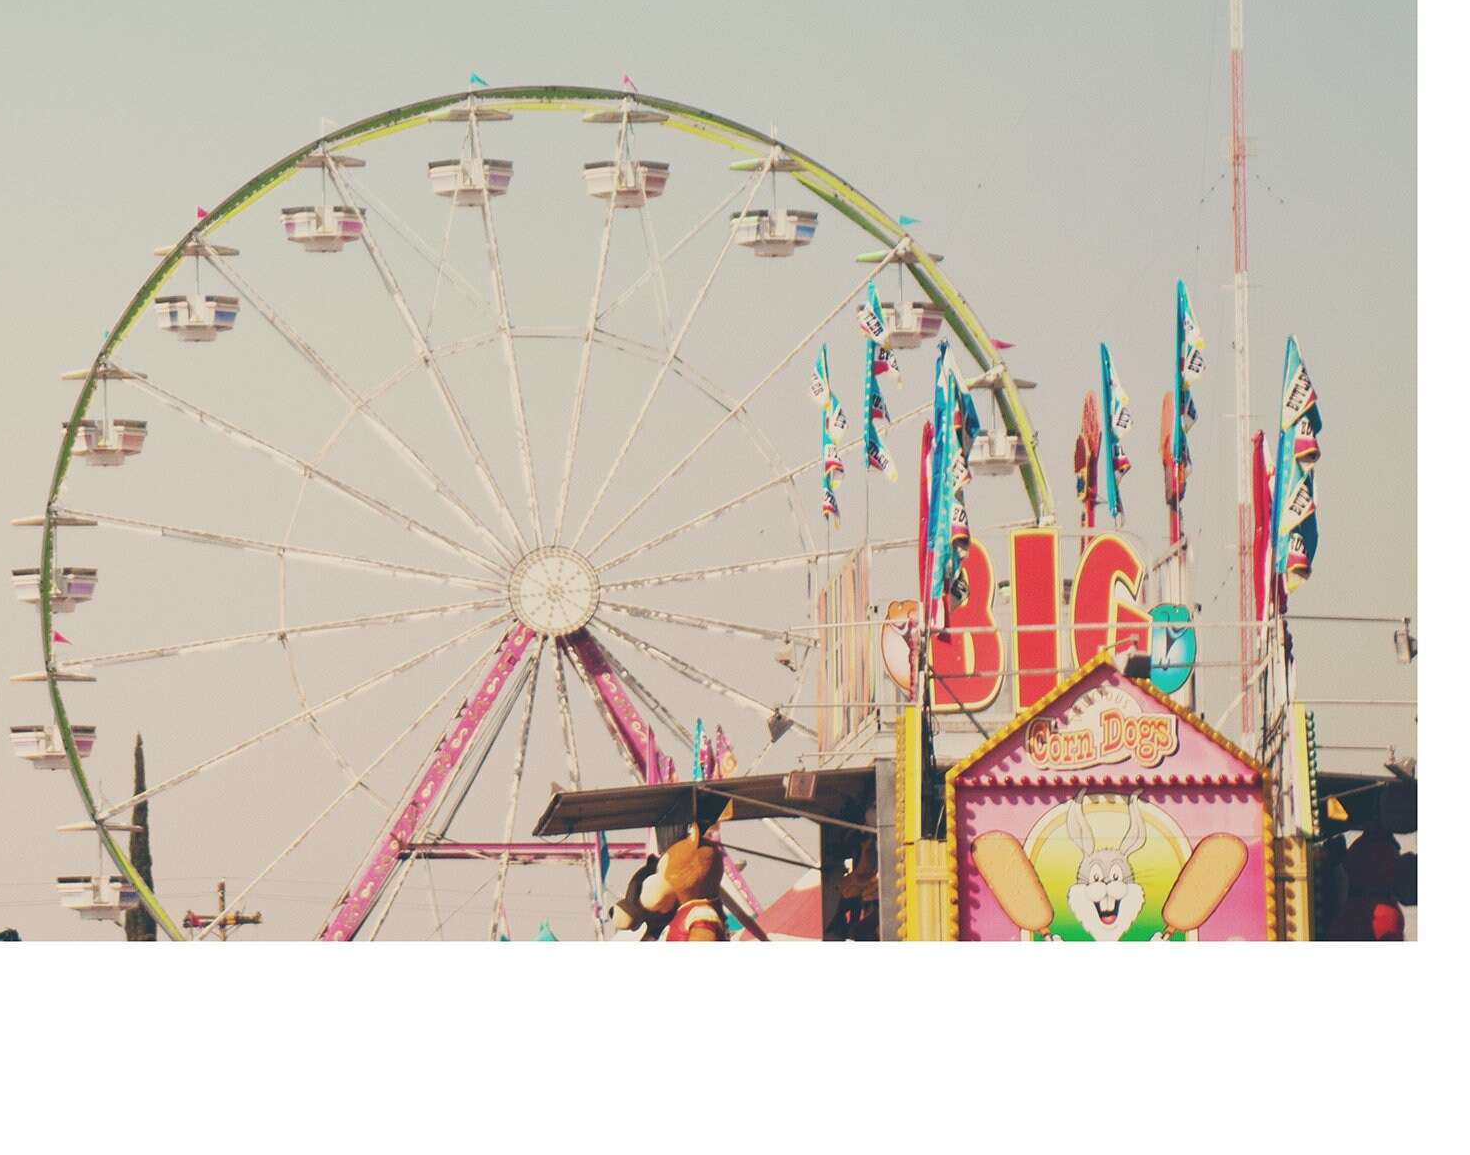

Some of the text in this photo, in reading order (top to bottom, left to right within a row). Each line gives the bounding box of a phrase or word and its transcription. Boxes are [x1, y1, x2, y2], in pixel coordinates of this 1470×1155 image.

[928, 527, 1155, 713] BIG
[1029, 708, 1174, 765] Corn Dogs
